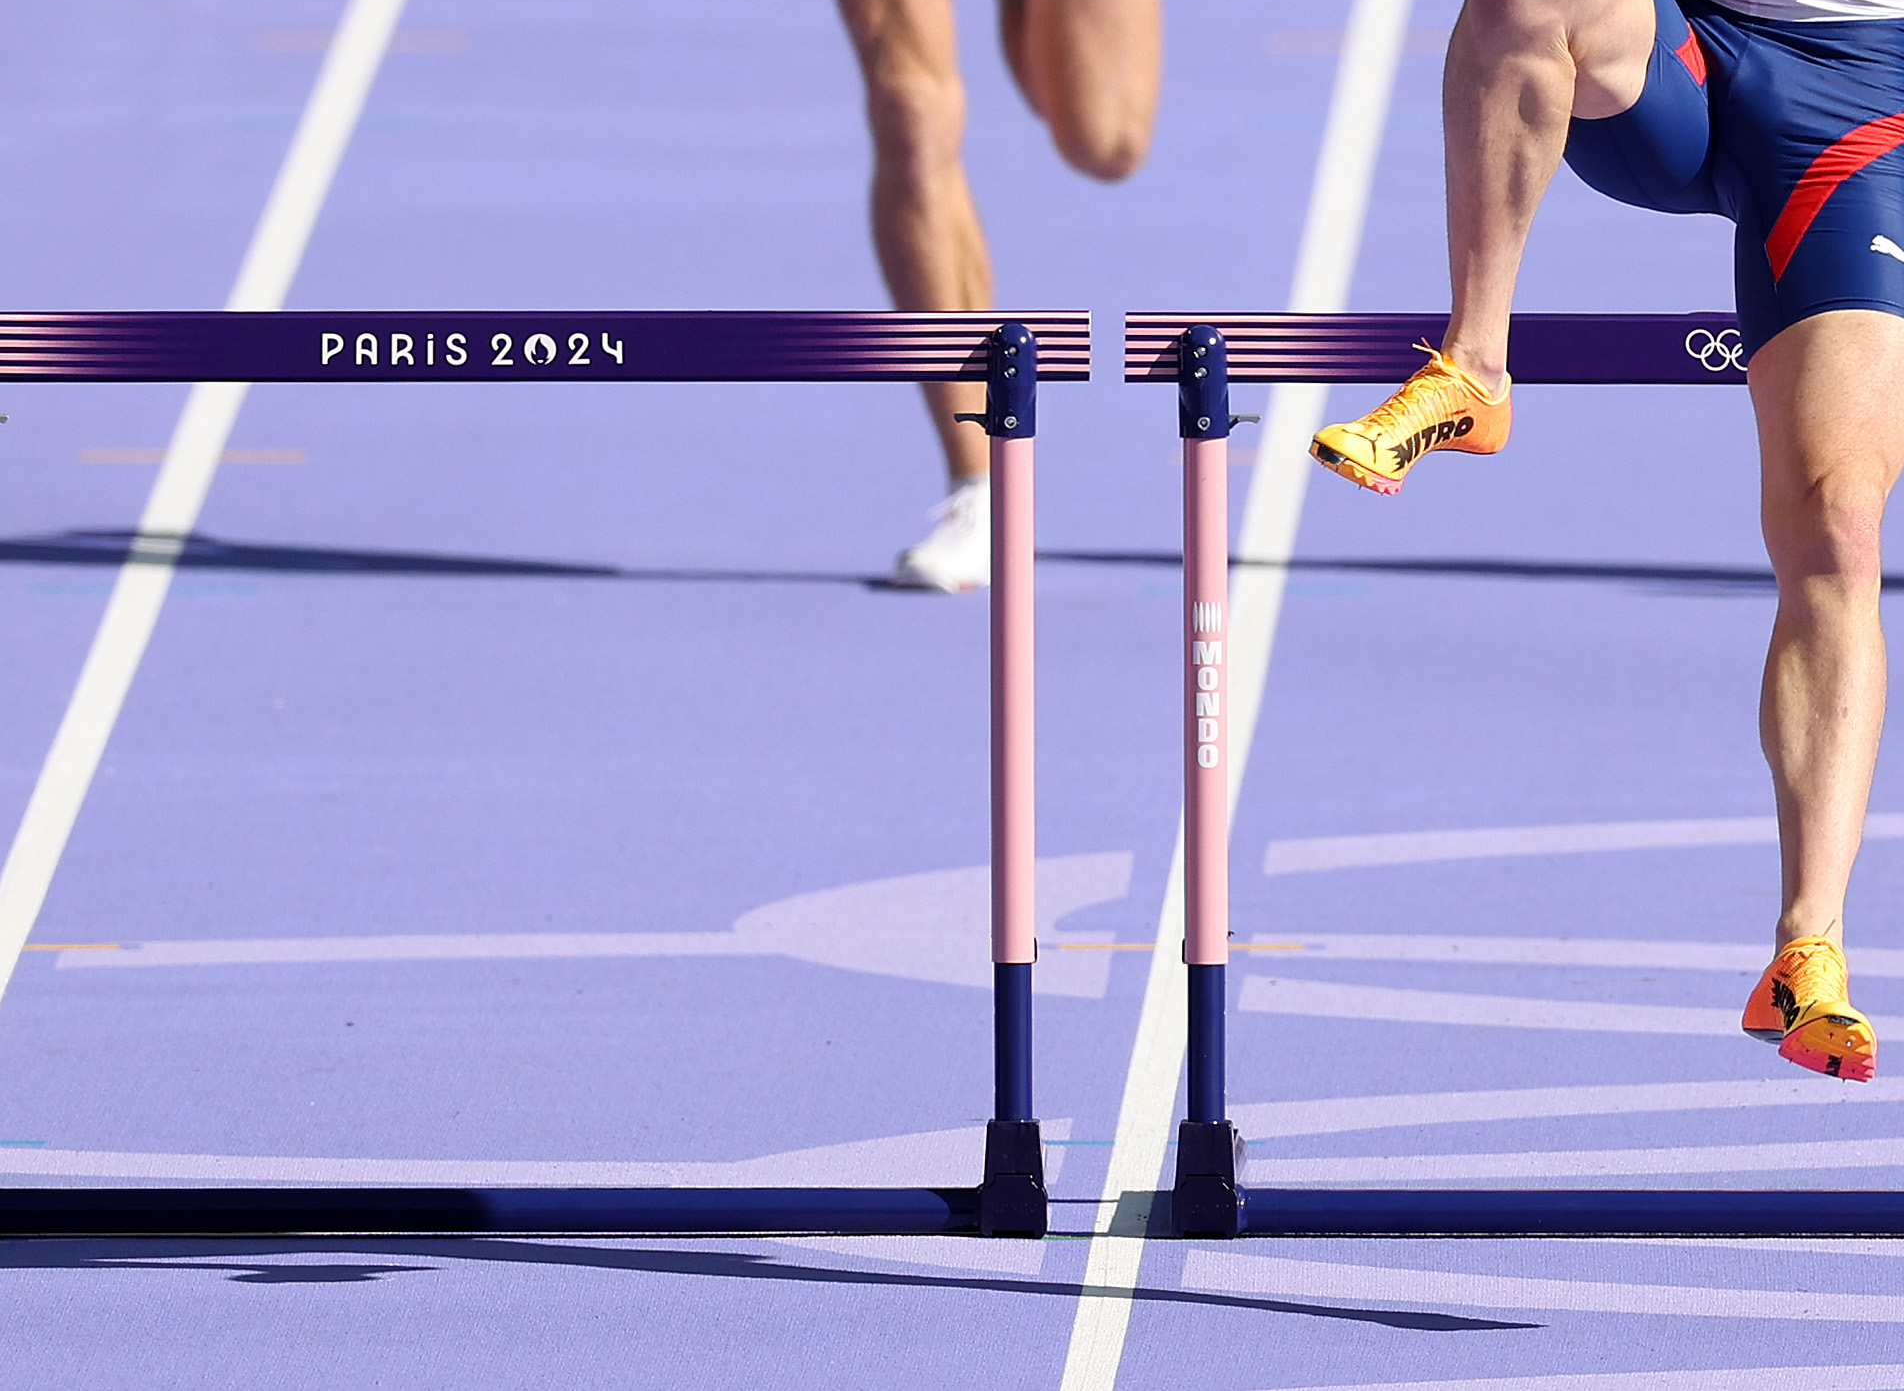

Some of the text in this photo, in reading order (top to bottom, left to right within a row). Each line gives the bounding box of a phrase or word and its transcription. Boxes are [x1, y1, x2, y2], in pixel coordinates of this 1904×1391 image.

[490, 332, 624, 366] 2024
[1386, 415, 1475, 474] NITRO
[1192, 640, 1223, 769] MONDO
